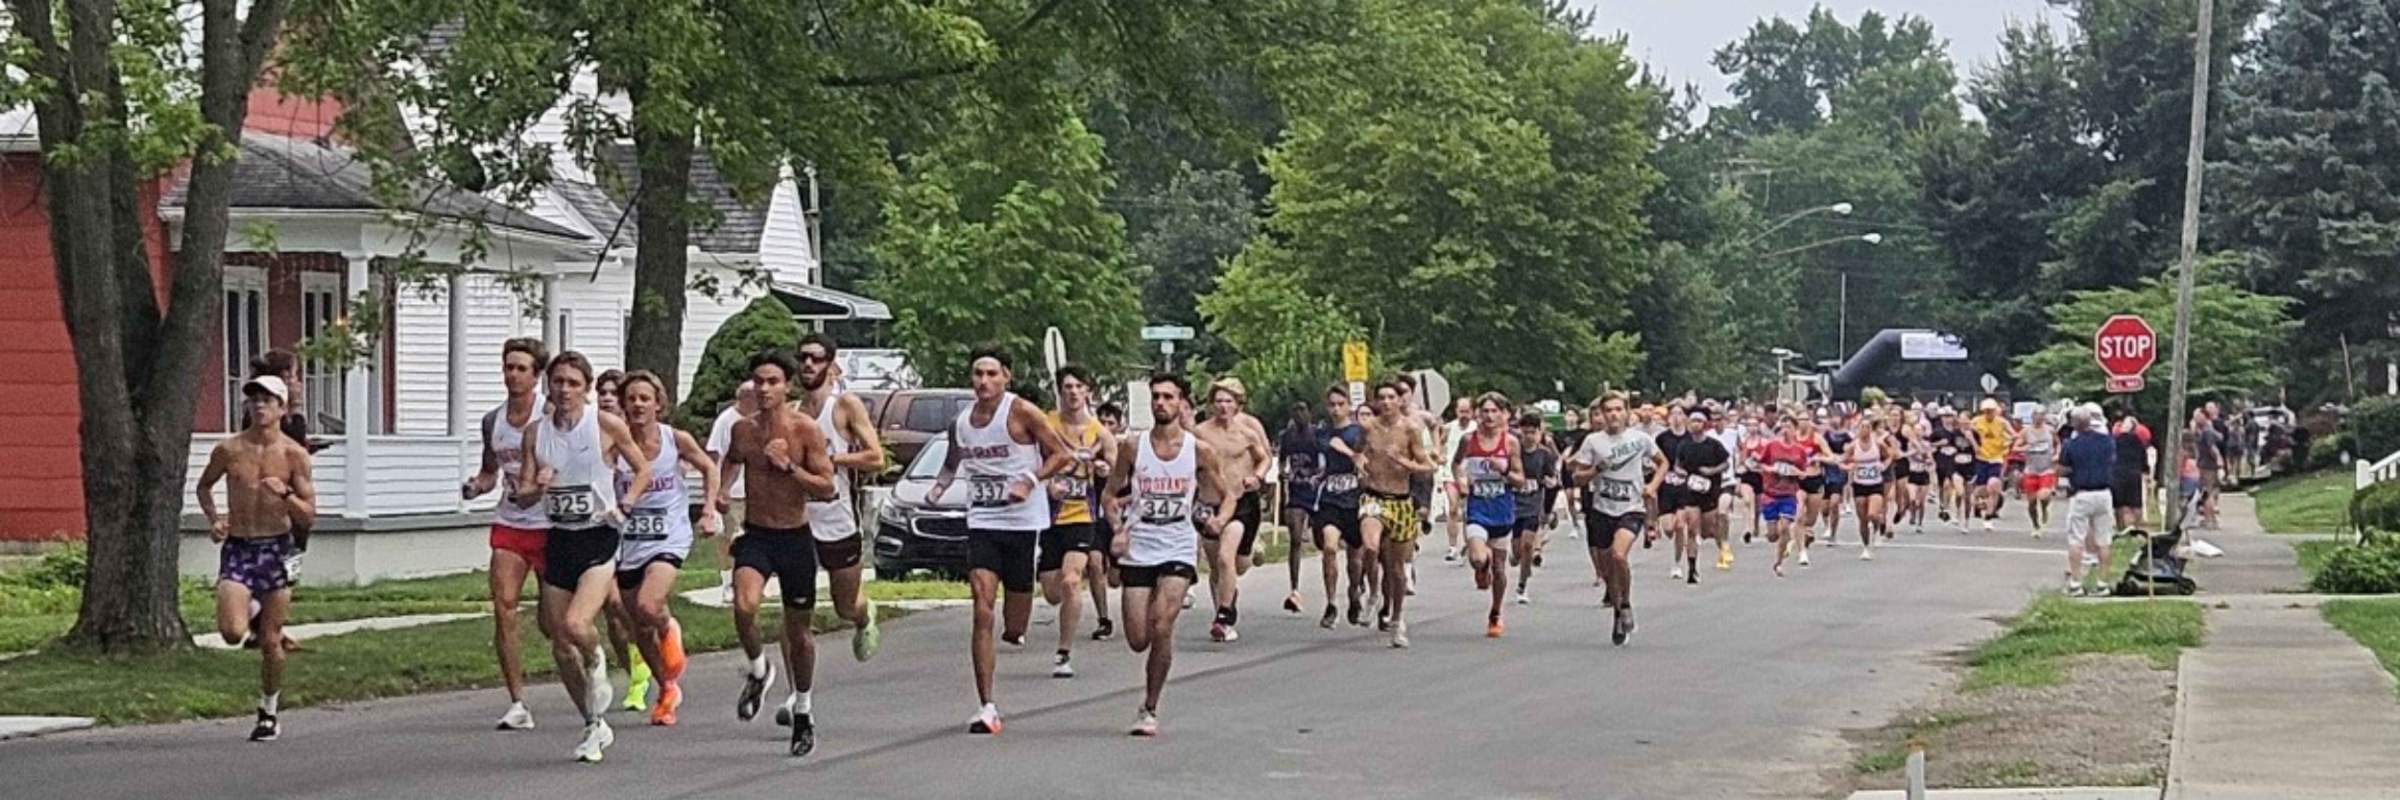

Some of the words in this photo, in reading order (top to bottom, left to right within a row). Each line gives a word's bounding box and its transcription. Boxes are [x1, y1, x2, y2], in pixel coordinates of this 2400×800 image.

[2100, 335, 2151, 358] STOP
[973, 481, 1005, 500] 337
[549, 494, 589, 513] 325
[1143, 500, 1183, 517] 347
[626, 517, 665, 533] 336
